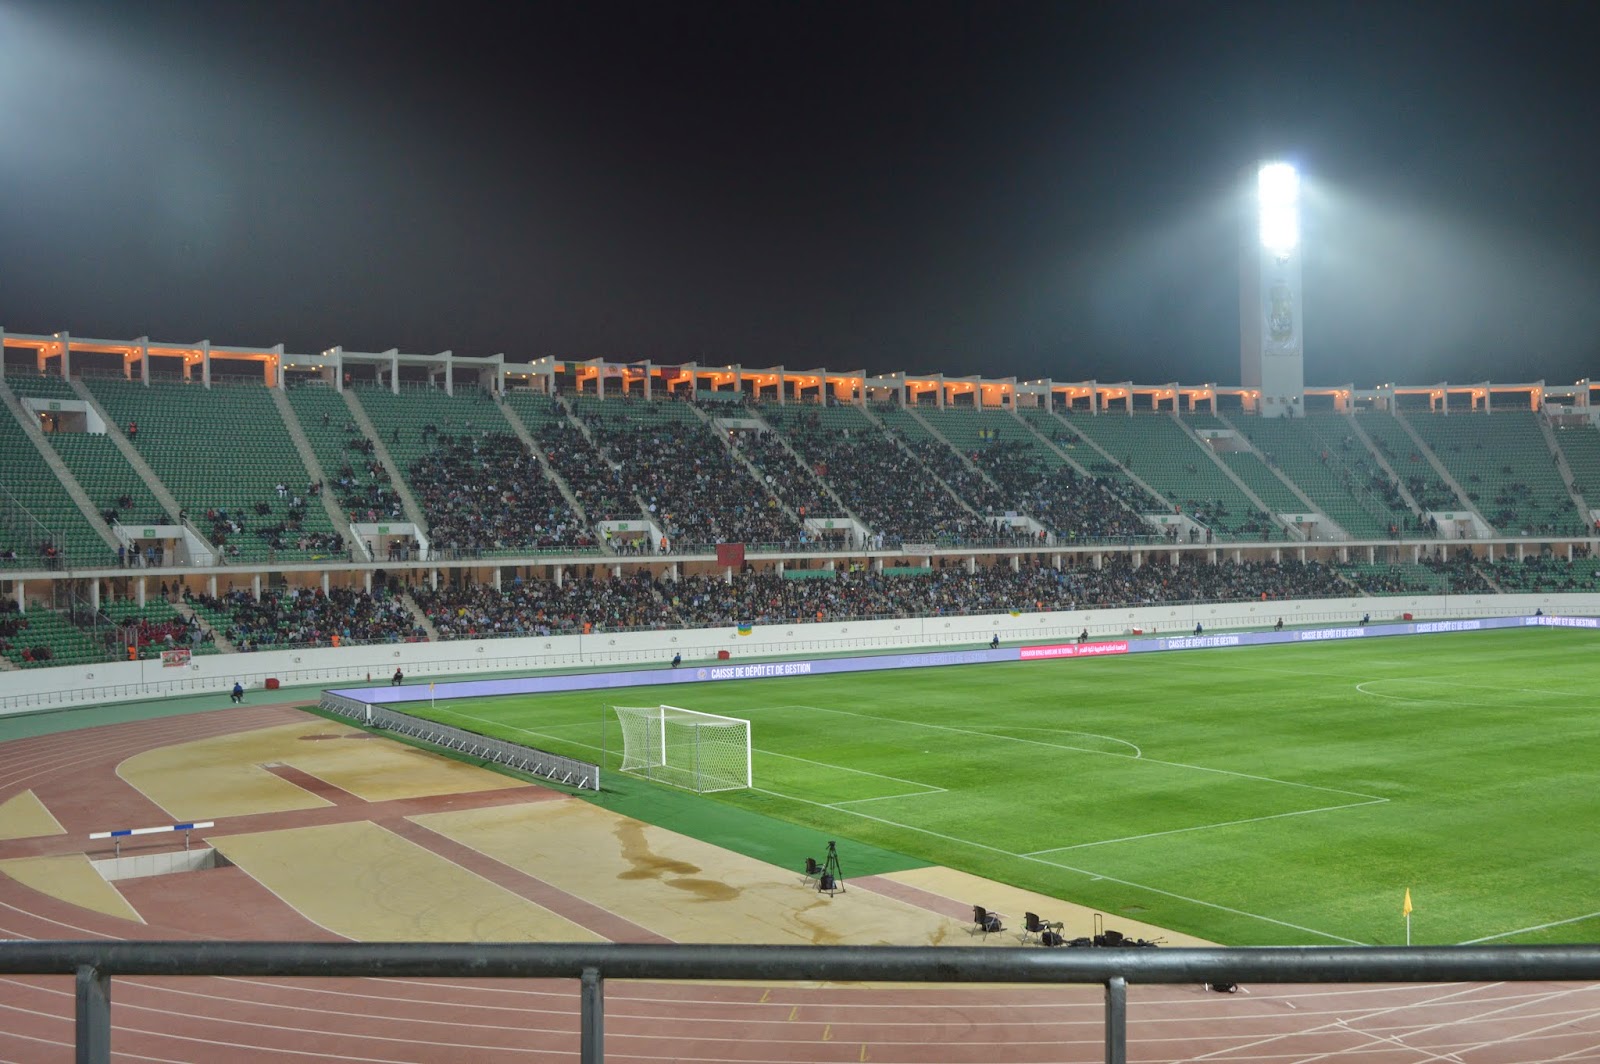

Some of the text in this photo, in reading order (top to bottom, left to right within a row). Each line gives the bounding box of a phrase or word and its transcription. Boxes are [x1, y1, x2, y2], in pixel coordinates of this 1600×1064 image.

[1538, 616, 1545, 625] DE
[1562, 618, 1568, 626] ET
[1568, 618, 1576, 626] DE
[1576, 618, 1597, 627] GESTION
[1186, 639, 1192, 648] DE
[1208, 638, 1213, 646] ET
[1214, 637, 1220, 646] DE
[1220, 636, 1238, 645] GESTION
[711, 664, 811, 679] CAISSE DE DÉPÔT ET DE GESTION
